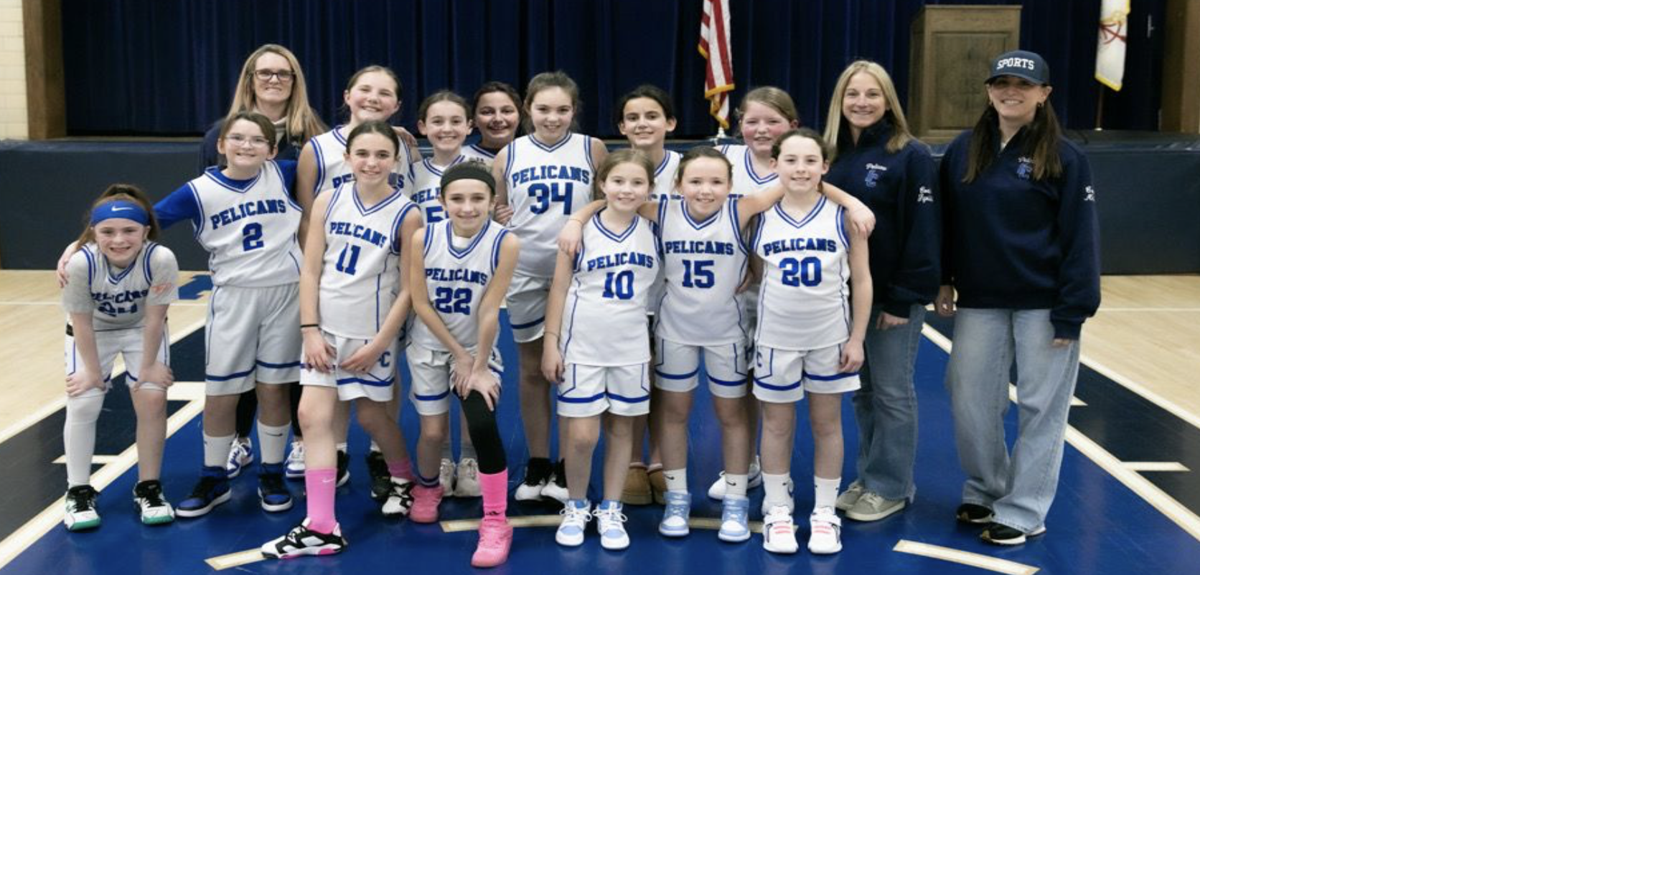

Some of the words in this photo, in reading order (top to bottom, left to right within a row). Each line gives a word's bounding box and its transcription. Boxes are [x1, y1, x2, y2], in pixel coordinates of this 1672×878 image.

[996, 56, 1035, 71] SPORTS
[512, 165, 590, 188] PELICANS
[527, 182, 574, 215] 34
[210, 199, 287, 230] PELICANS
[242, 222, 264, 252] 2
[664, 240, 735, 256] PELICANS
[763, 238, 837, 256] PELICANS
[335, 242, 361, 276] 11
[587, 252, 655, 272] PELICANS
[779, 256, 822, 287] 20
[425, 268, 488, 286] PELICANS
[602, 270, 635, 300] 10
[681, 259, 715, 289] 15
[435, 286, 473, 315] 22
